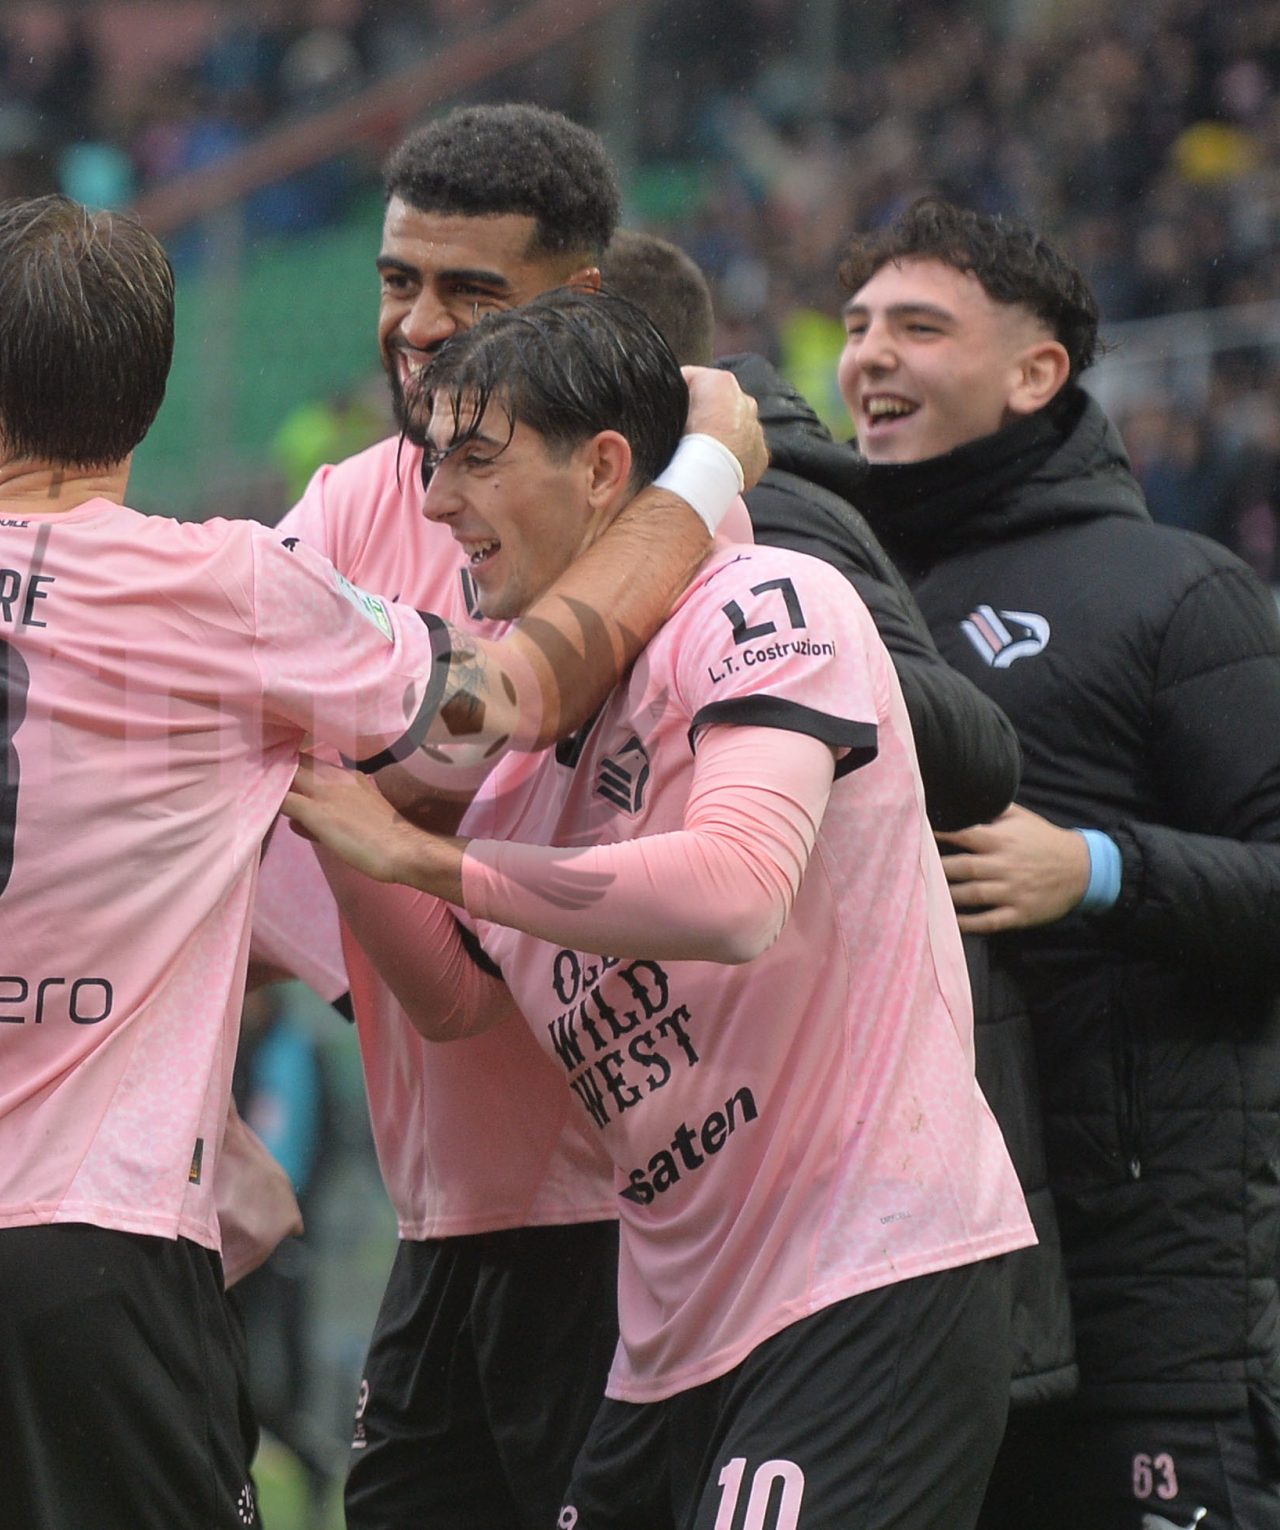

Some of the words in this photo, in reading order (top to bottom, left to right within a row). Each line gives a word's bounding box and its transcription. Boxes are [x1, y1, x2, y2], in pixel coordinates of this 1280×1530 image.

[707, 656, 741, 685] L.T.
[742, 638, 837, 667] Costruzioni
[552, 949, 621, 1006] OL
[548, 959, 669, 1073] WILD
[570, 1004, 700, 1130] WEST
[618, 1085, 759, 1206] saten
[713, 1457, 805, 1530] 10
[1133, 1452, 1179, 1500] 63
